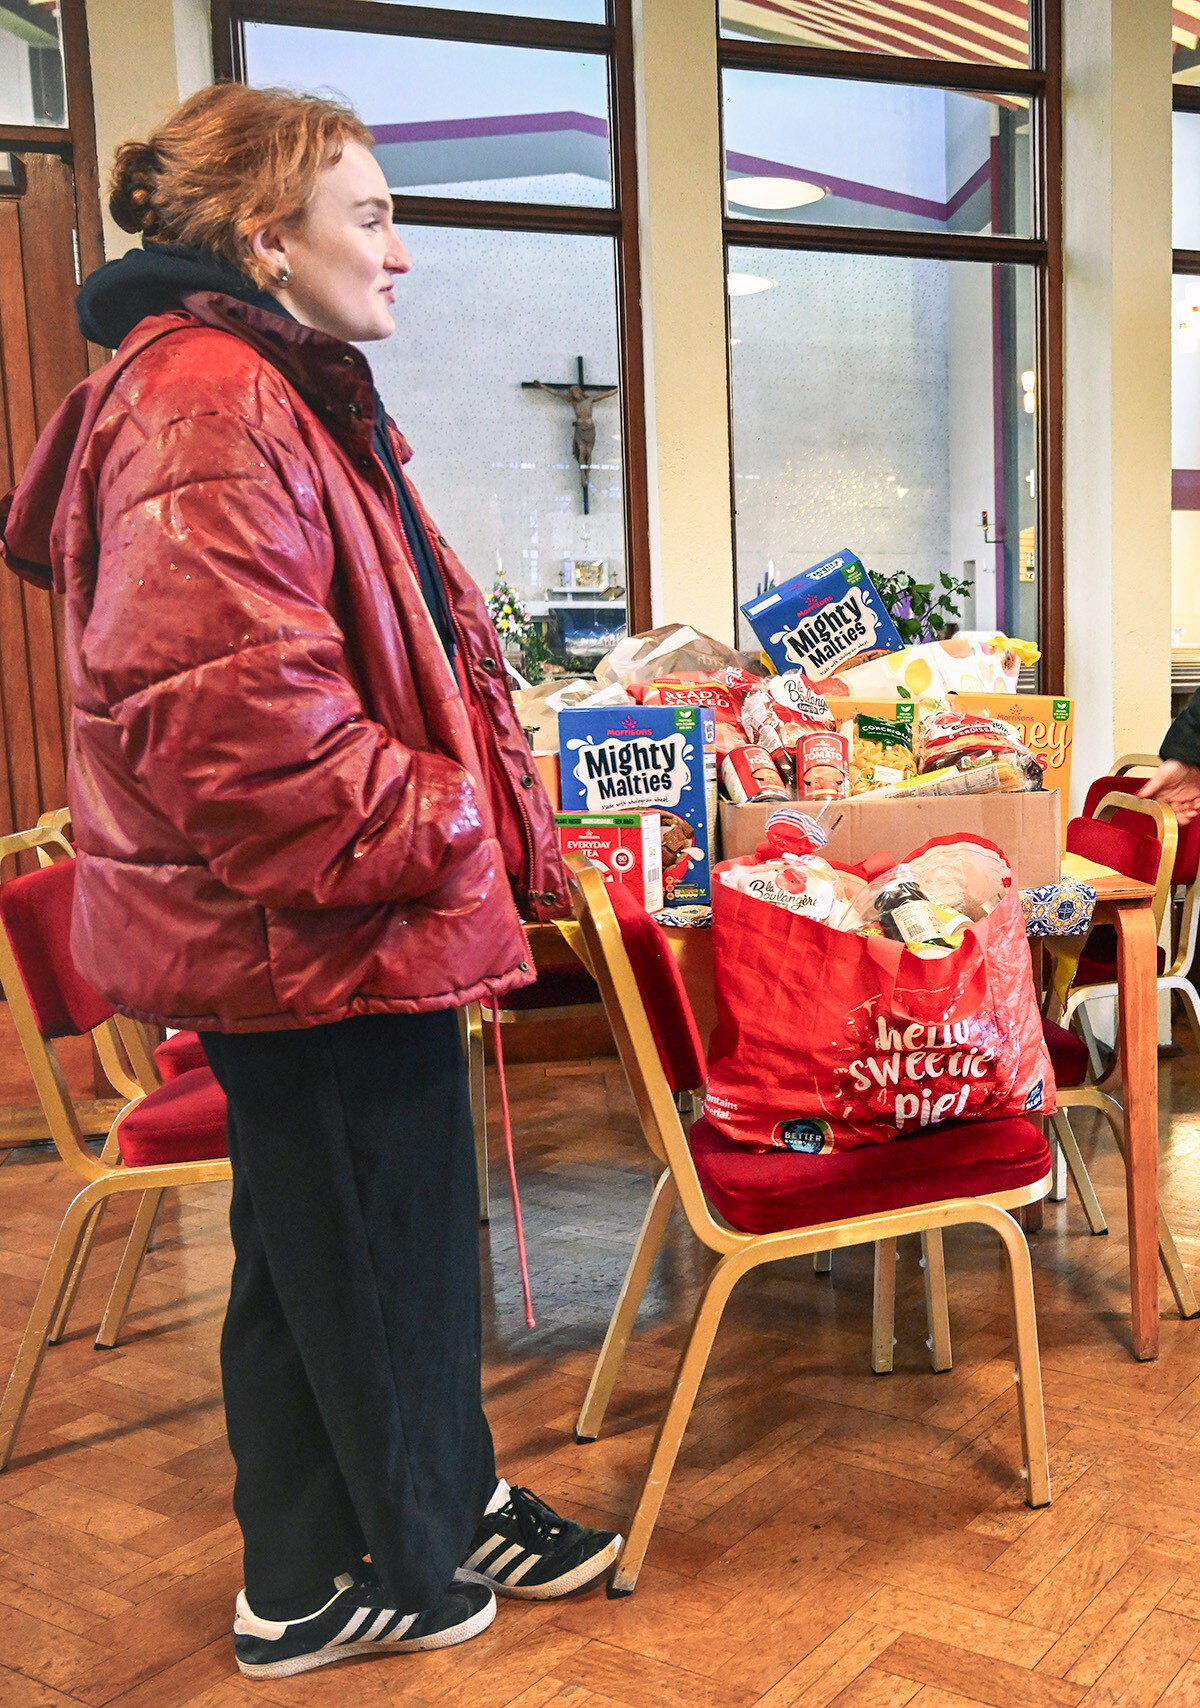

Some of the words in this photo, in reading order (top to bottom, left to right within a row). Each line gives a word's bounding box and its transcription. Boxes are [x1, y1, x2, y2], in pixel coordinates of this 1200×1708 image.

[797, 596, 833, 618] Morrisons
[787, 595, 862, 659] Mighty
[807, 620, 866, 669] Malties
[664, 690, 721, 700] READY
[664, 698, 730, 708] SALTED
[996, 714, 1035, 722] Morrisons
[607, 728, 653, 737] Morrisons
[1017, 721, 1072, 769] ney
[584, 741, 676, 780] Mighty
[803, 751, 843, 762] TOMATO
[597, 772, 672, 800] Malties
[567, 840, 612, 849] EVERYDAY
[582, 849, 599, 858] TEA
[765, 880, 775, 893] la
[875, 1012, 970, 1051] hello
[849, 1046, 995, 1092] sweetie
[706, 1093, 739, 1111] ontains
[894, 1083, 971, 1130] pie!
[784, 1131, 822, 1142] BETTER
